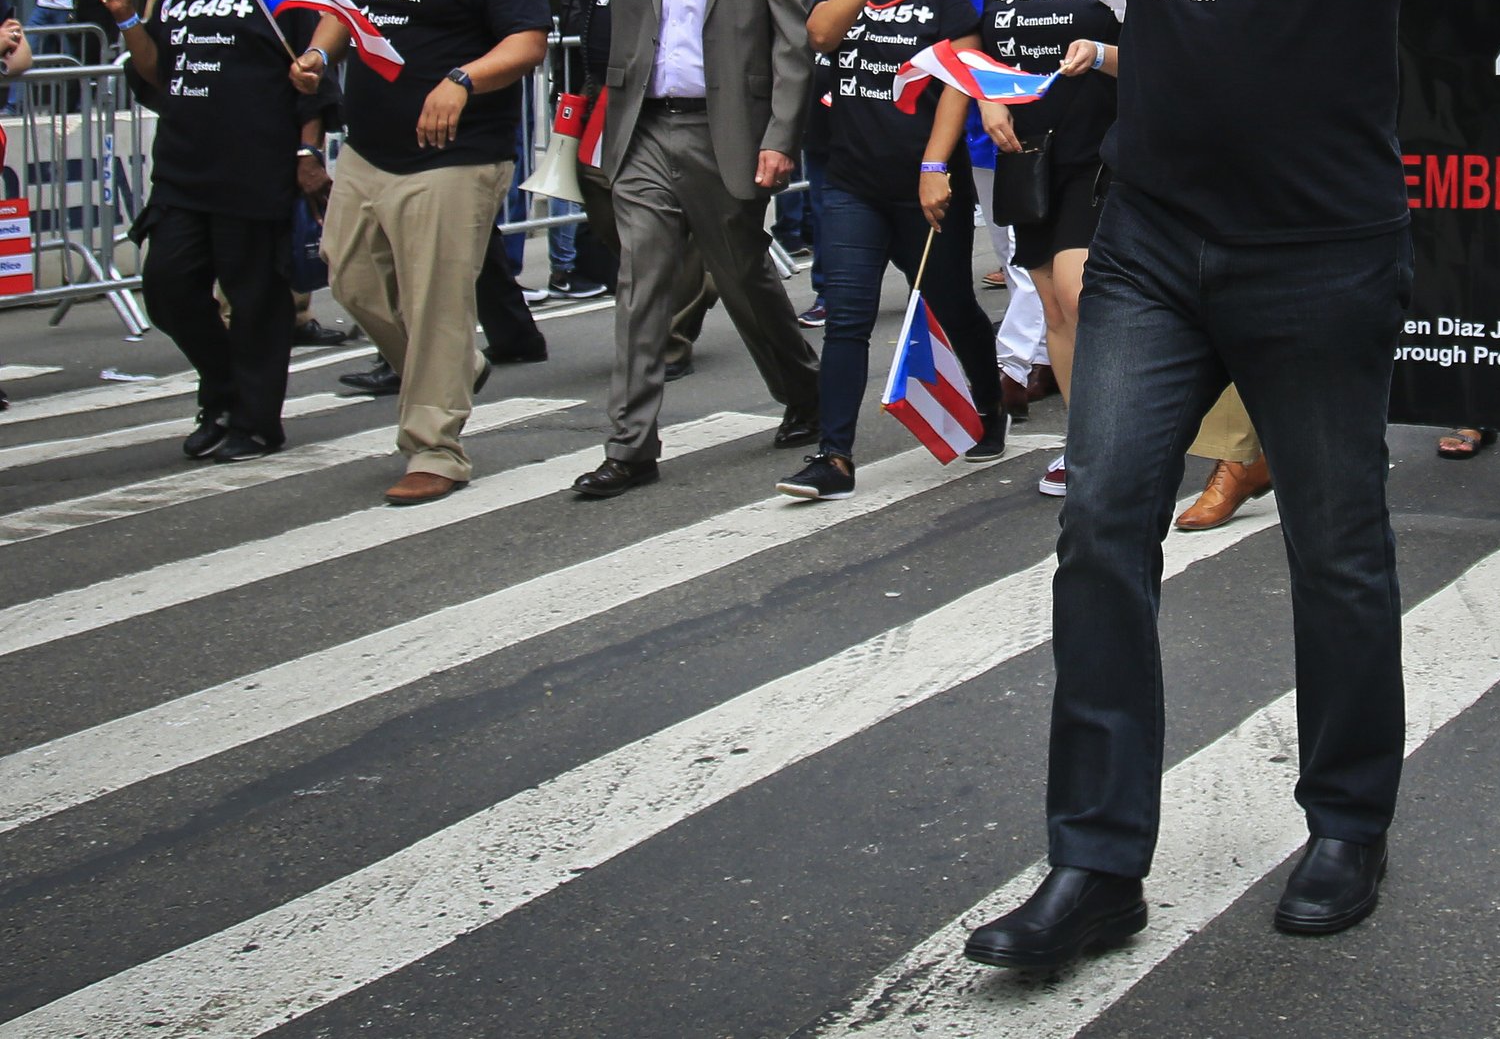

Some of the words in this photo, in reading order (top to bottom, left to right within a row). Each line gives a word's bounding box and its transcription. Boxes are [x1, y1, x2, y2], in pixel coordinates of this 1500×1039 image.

[368, 12, 409, 27] Register!
[1016, 12, 1074, 27] Remember!
[186, 32, 236, 45] Remember!
[1020, 45, 1061, 59] Register!
[860, 58, 901, 75] Register!
[182, 86, 209, 98] Resist!
[859, 86, 892, 100] Resist!
[1401, 319, 1431, 335] en
[1437, 317, 1485, 338] Diaz
